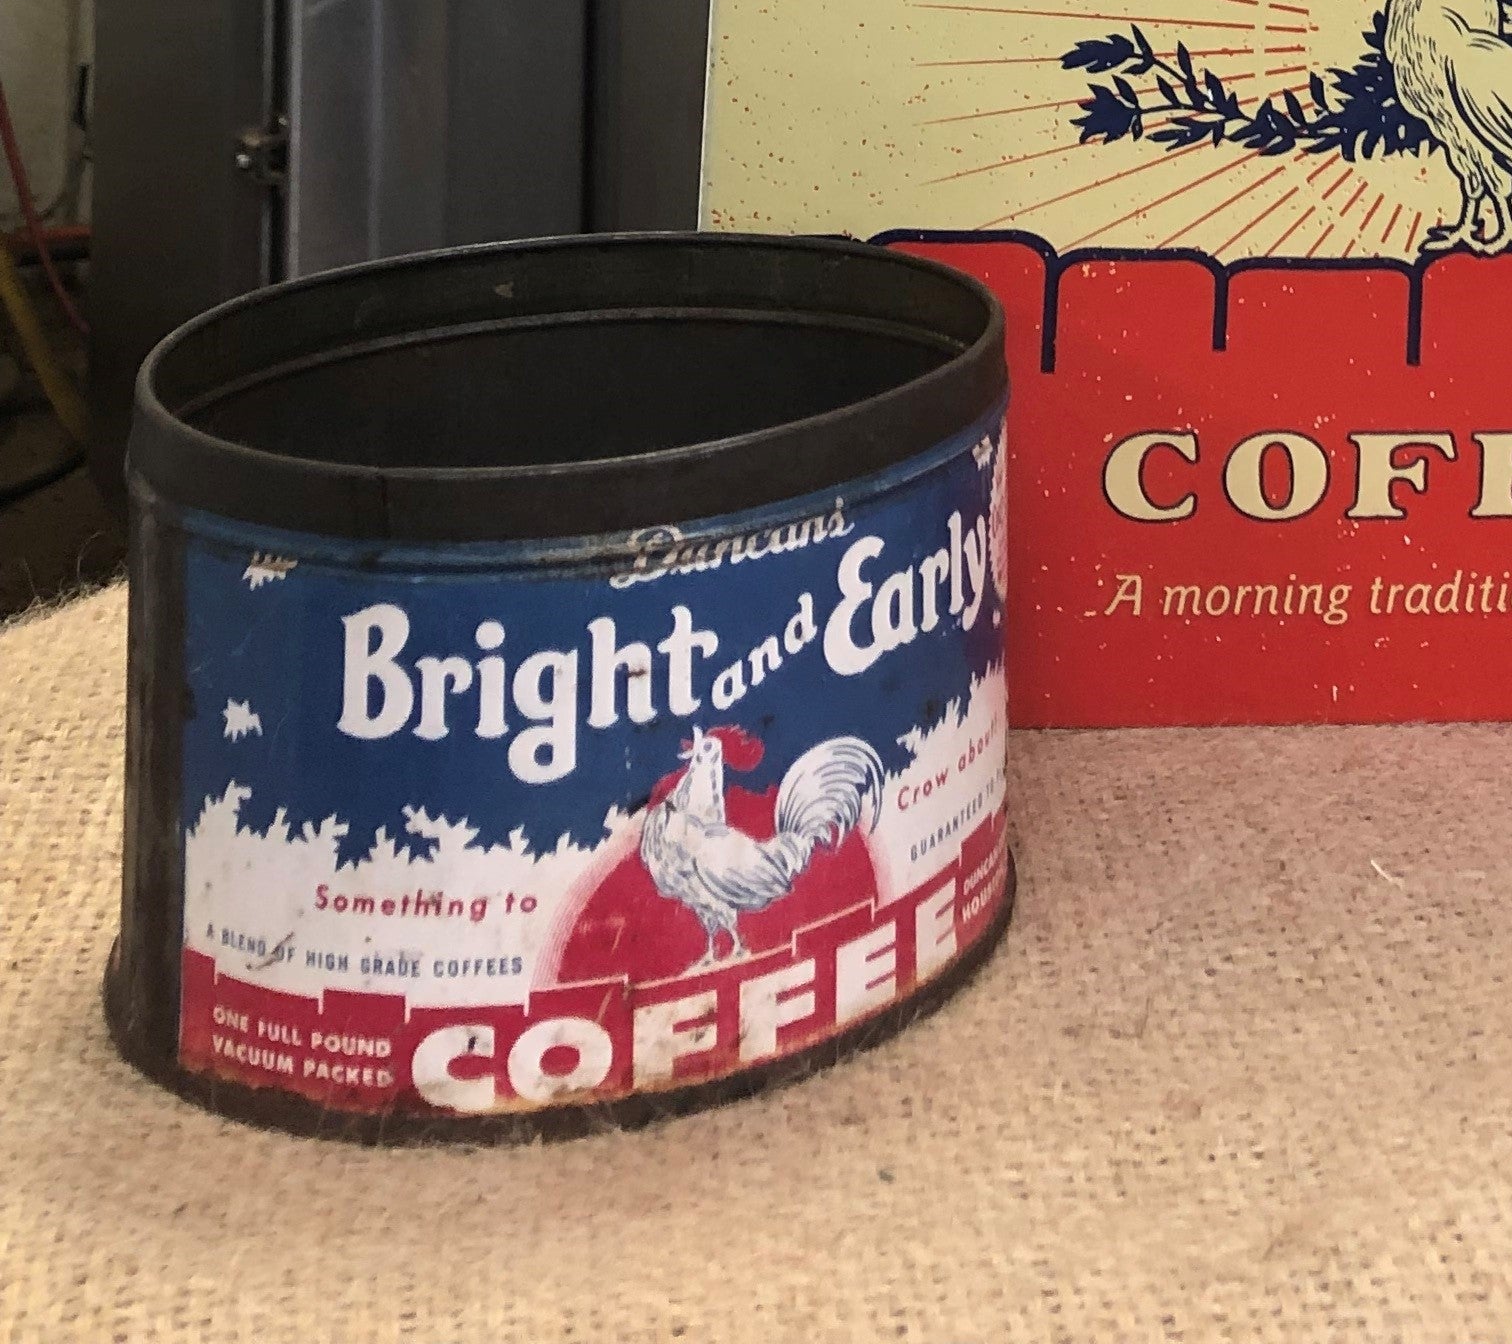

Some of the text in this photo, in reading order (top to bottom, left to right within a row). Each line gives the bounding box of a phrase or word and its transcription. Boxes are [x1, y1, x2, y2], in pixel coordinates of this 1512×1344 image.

[1104, 573, 1144, 617] A
[1161, 576, 1354, 627] morning
[337, 510, 986, 786] Bright and Early
[896, 768, 949, 812] Crow
[910, 792, 983, 863] GUARANTEED
[313, 883, 538, 923] Something to
[206, 923, 523, 979] A BLEND OF HIGH GRADE COFFEES
[411, 878, 958, 1115] COFFEE
[212, 1005, 392, 1059] ONE FULL POUND
[212, 1033, 395, 1089] VACUUM PACKED
